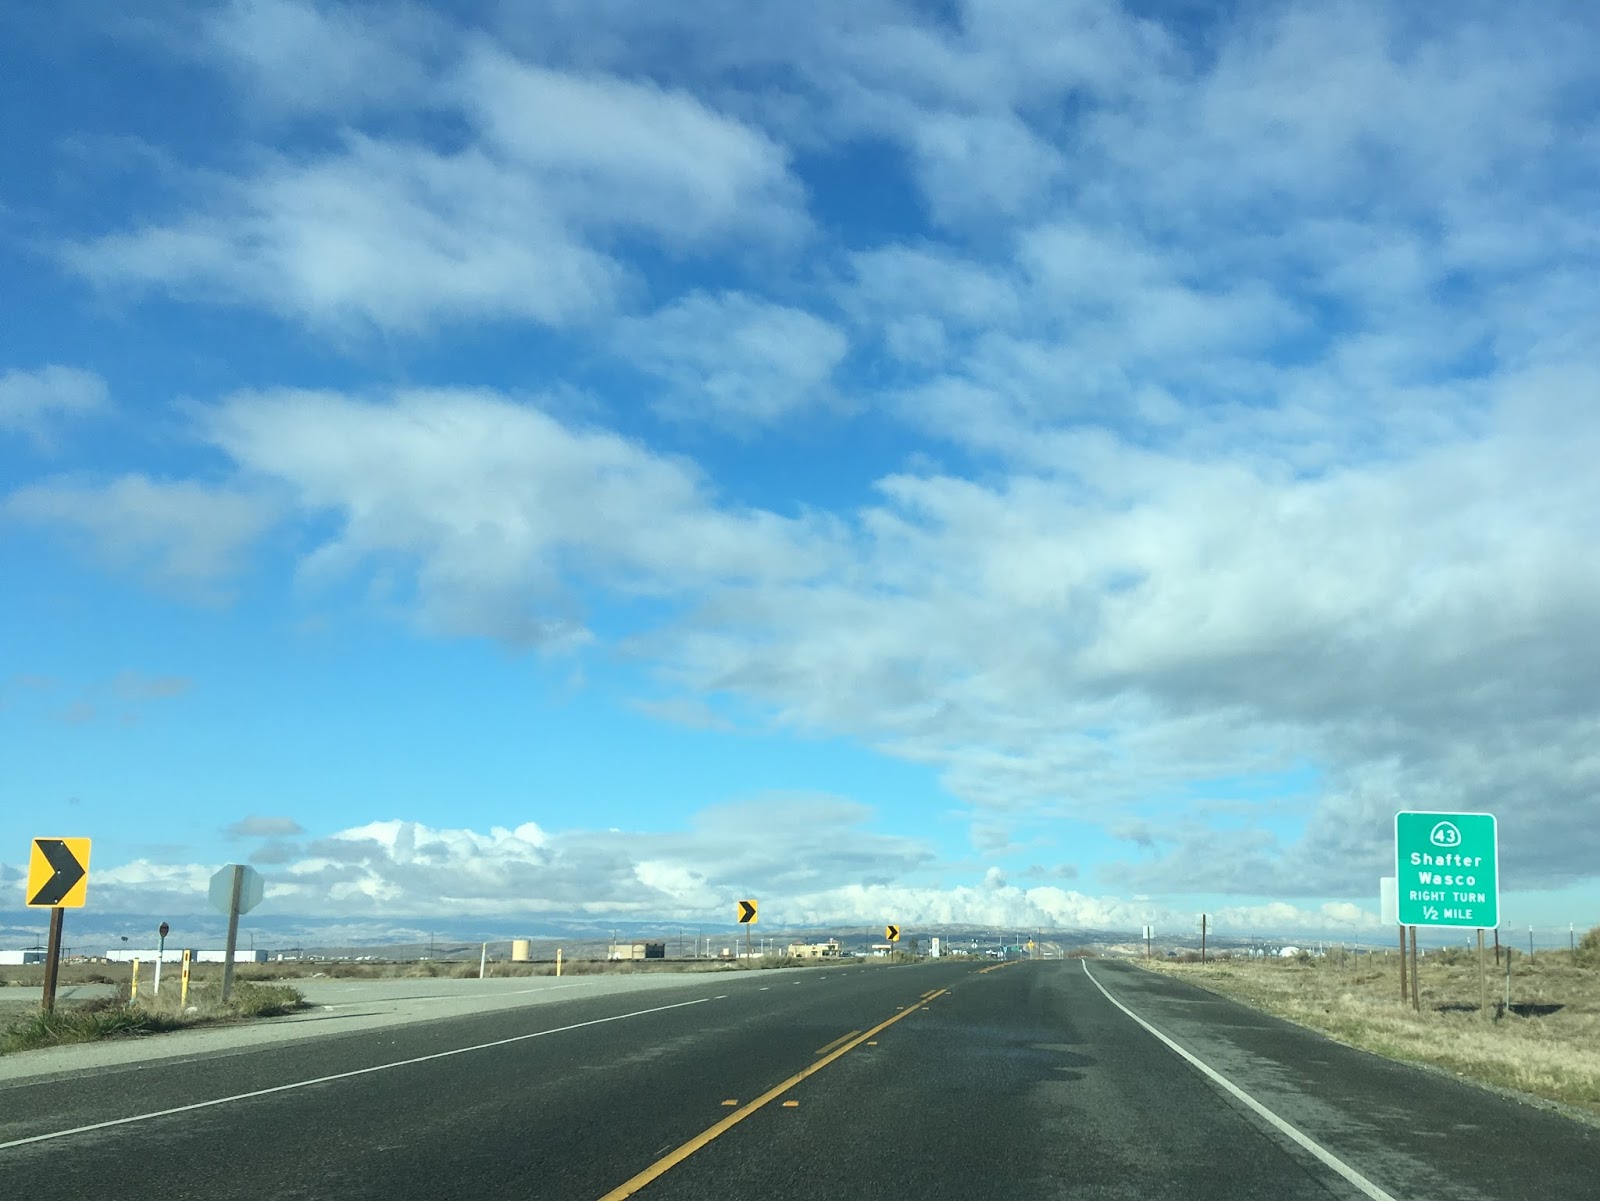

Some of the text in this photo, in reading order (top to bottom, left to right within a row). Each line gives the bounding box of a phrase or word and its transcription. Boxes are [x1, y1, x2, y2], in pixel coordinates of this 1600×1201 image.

[1435, 829, 1456, 843] 43
[1410, 852, 1482, 867] Shafter
[1418, 871, 1476, 886] Wasco
[1409, 890, 1486, 903] RIGHT TURN
[1443, 909, 1473, 920] MILE
